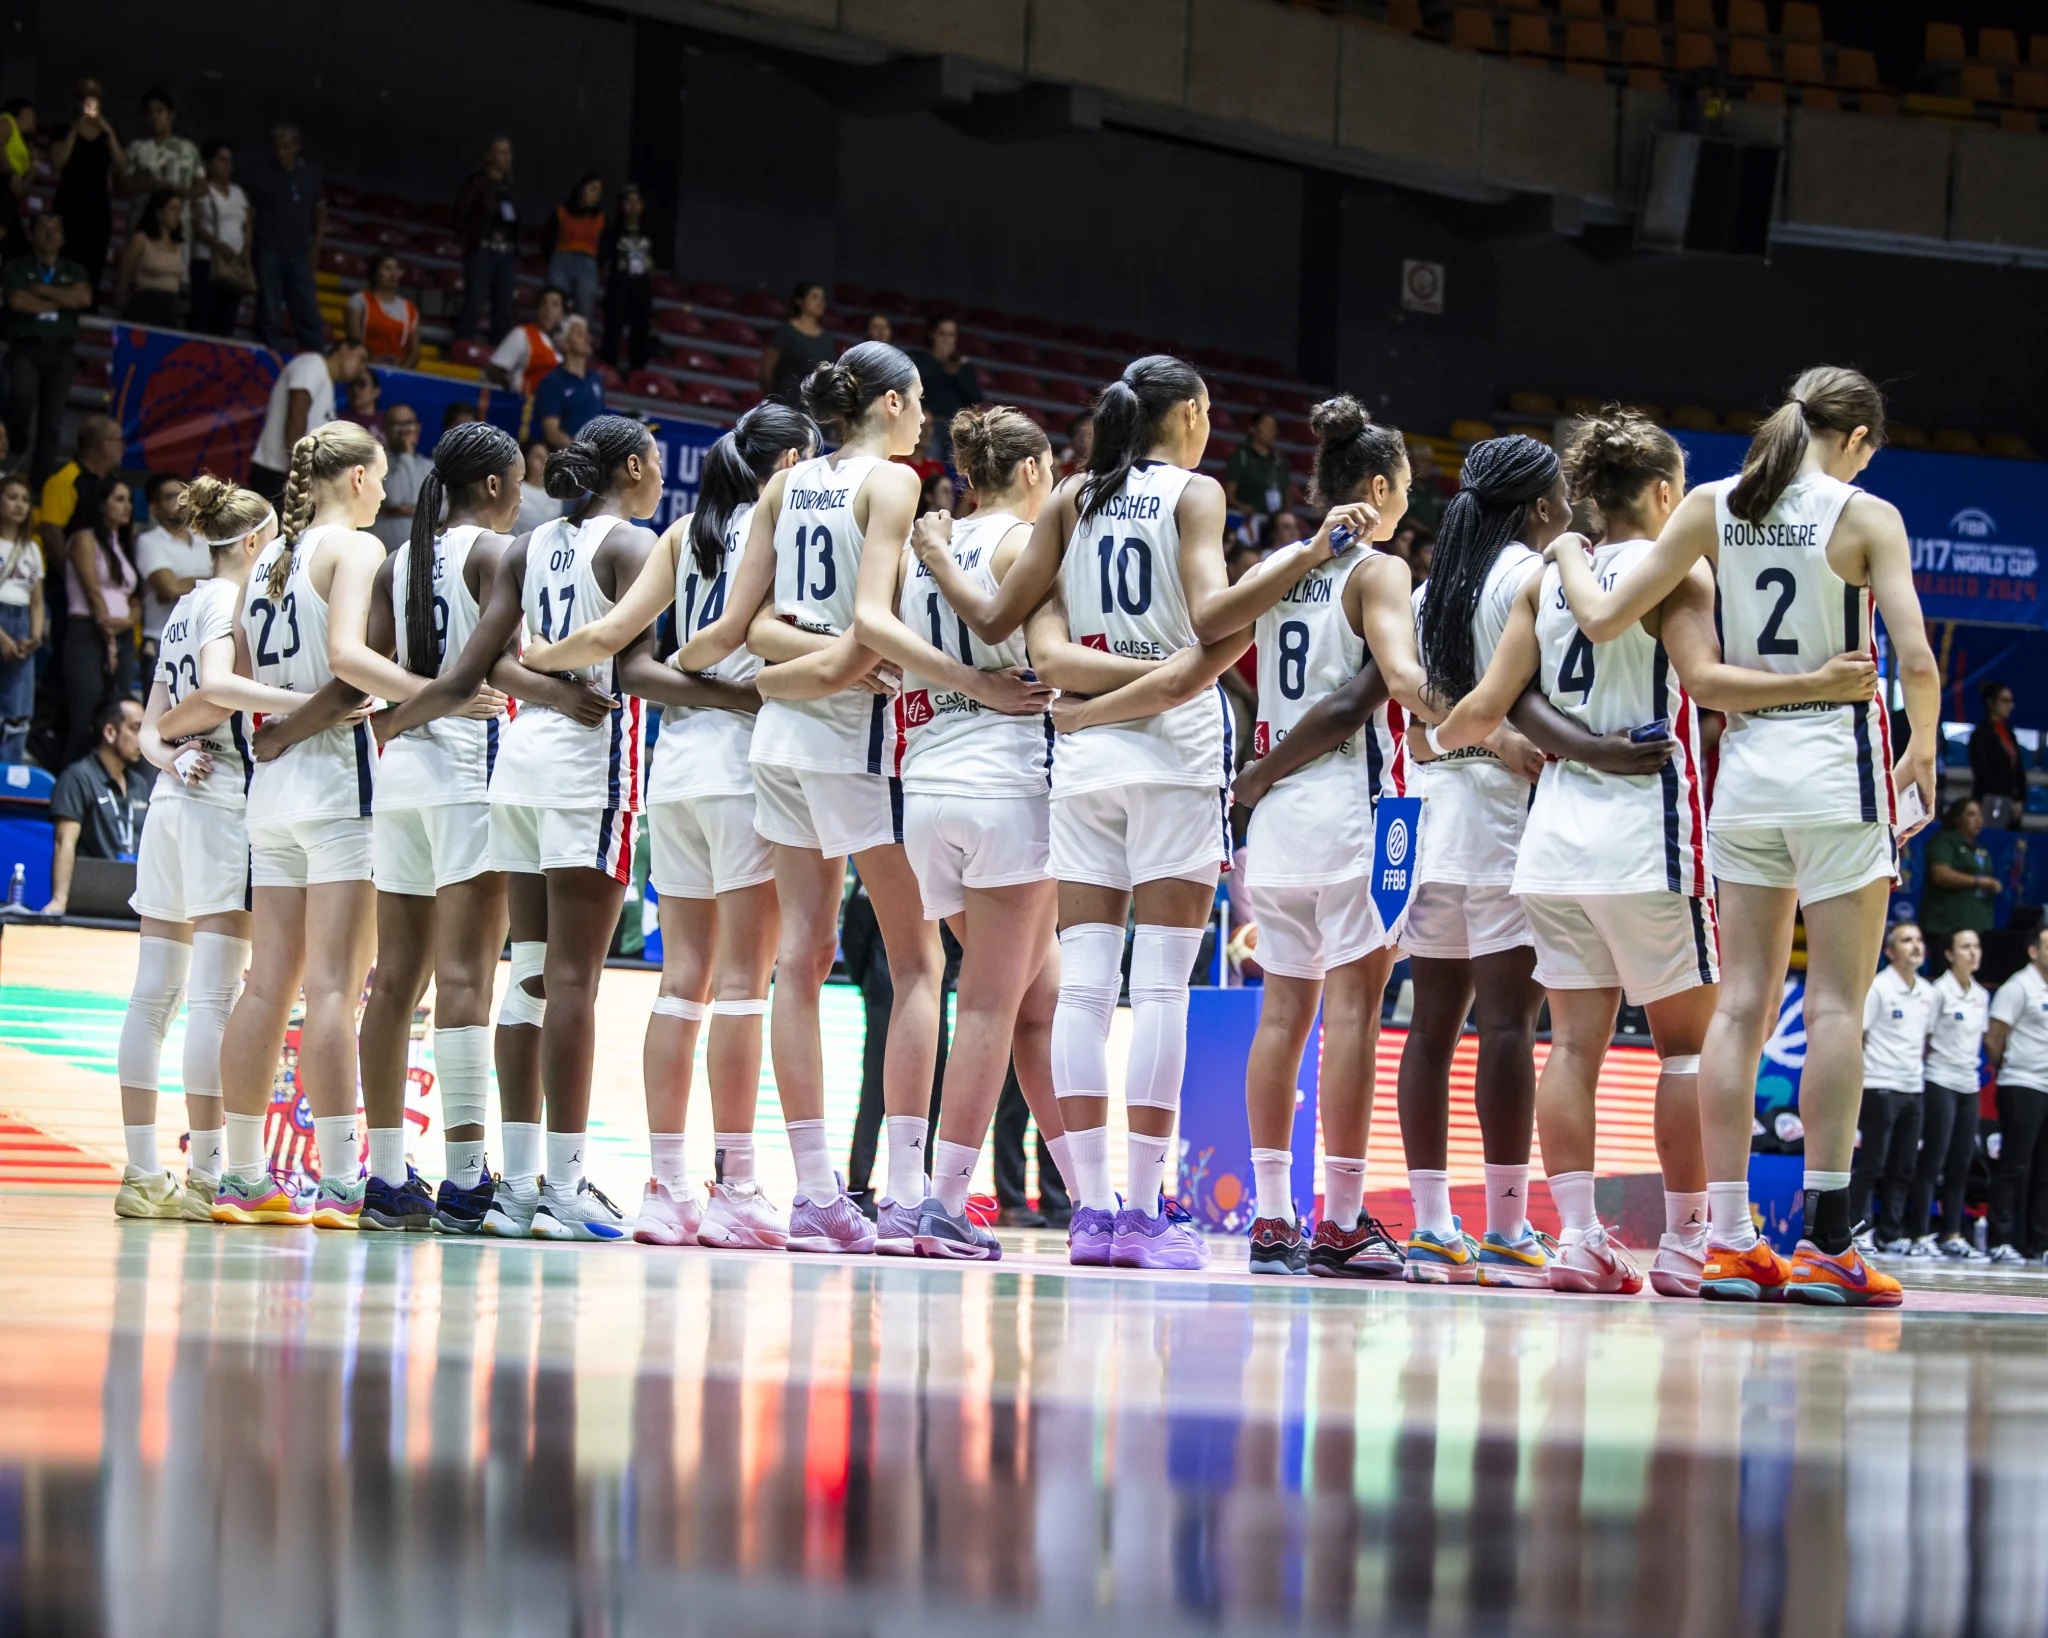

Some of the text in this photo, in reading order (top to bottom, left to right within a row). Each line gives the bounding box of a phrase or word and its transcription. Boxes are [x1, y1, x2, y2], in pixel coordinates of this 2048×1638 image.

[796, 525, 836, 601] 13
[1098, 535, 1152, 616] 10
[1952, 553, 2038, 578] WORLD CUP
[250, 591, 300, 667] 23
[539, 584, 575, 644] 17
[685, 572, 728, 645] 14
[1756, 567, 1799, 655] 2
[1113, 640, 1160, 655] CAISSE
[1279, 621, 1310, 700] 8
[1558, 627, 1595, 706] 4
[1382, 868, 1407, 891] FFBB
